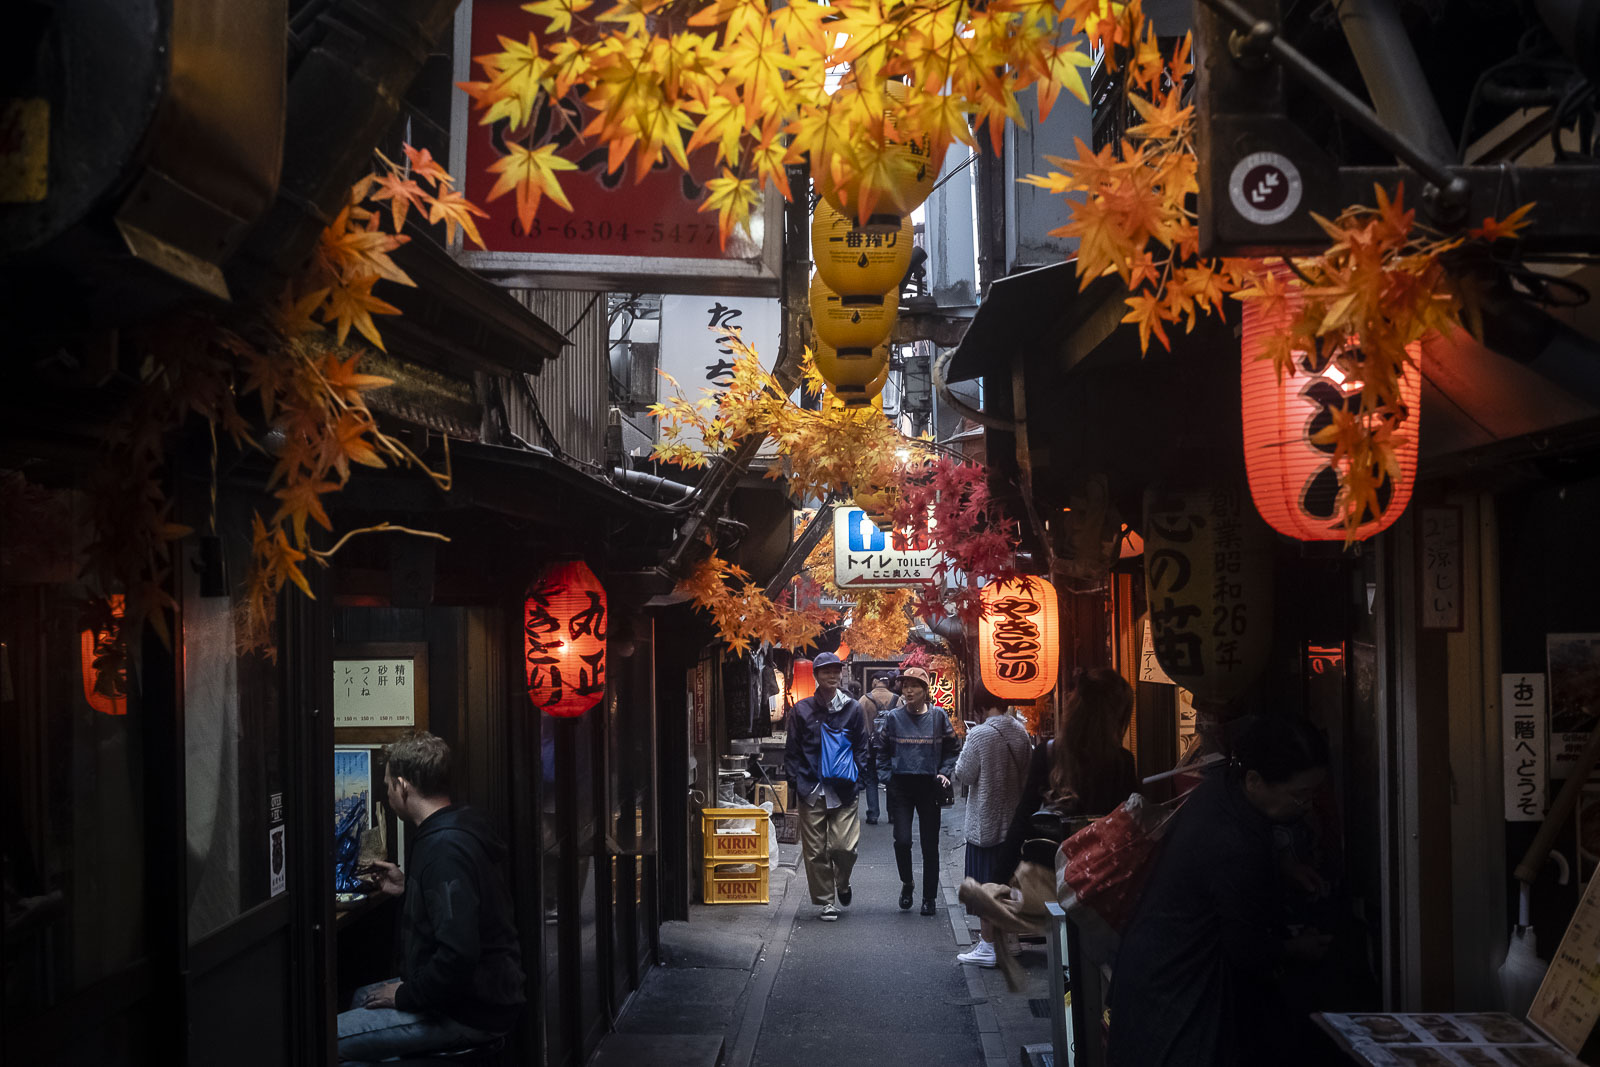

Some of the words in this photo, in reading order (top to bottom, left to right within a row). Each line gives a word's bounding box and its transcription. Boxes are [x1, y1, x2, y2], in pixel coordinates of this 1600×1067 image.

[829, 231, 897, 248] 一番搾り
[848, 554, 892, 570] トイレ
[897, 558, 932, 567] TOILET
[873, 569, 921, 578] ここ奥入る
[568, 590, 606, 696] 丸正
[992, 597, 1040, 682] やきとり
[344, 667, 354, 698] レバー
[361, 666, 371, 697] つくね
[378, 664, 389, 687] 砂肝
[395, 664, 406, 687] 精肉
[717, 838, 757, 849] KIRIN
[717, 882, 757, 895] KIRIN
